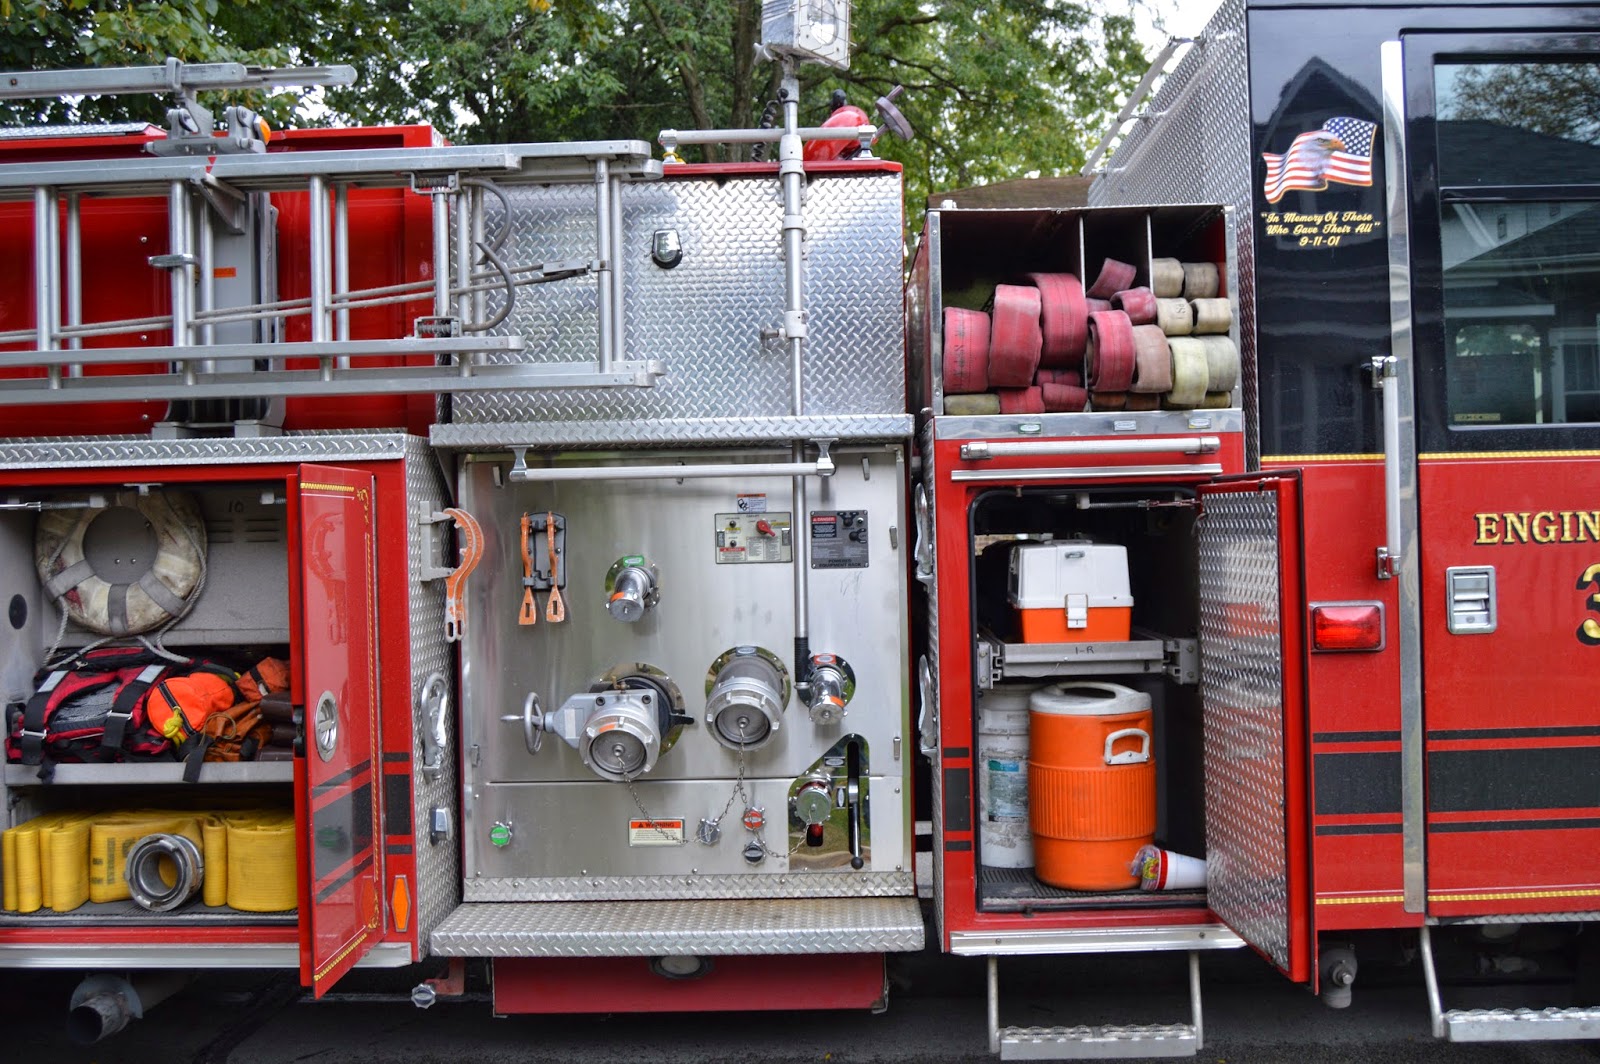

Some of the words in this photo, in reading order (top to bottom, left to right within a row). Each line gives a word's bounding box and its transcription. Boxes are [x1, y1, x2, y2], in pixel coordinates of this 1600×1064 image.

[1283, 212, 1323, 225] Memory
[1324, 211, 1338, 223] Of
[1342, 211, 1373, 222] Those
[1266, 224, 1290, 235] Who
[1293, 224, 1319, 235] Gave
[1322, 223, 1351, 235] Their
[1299, 236, 1341, 247] 9-11-01
